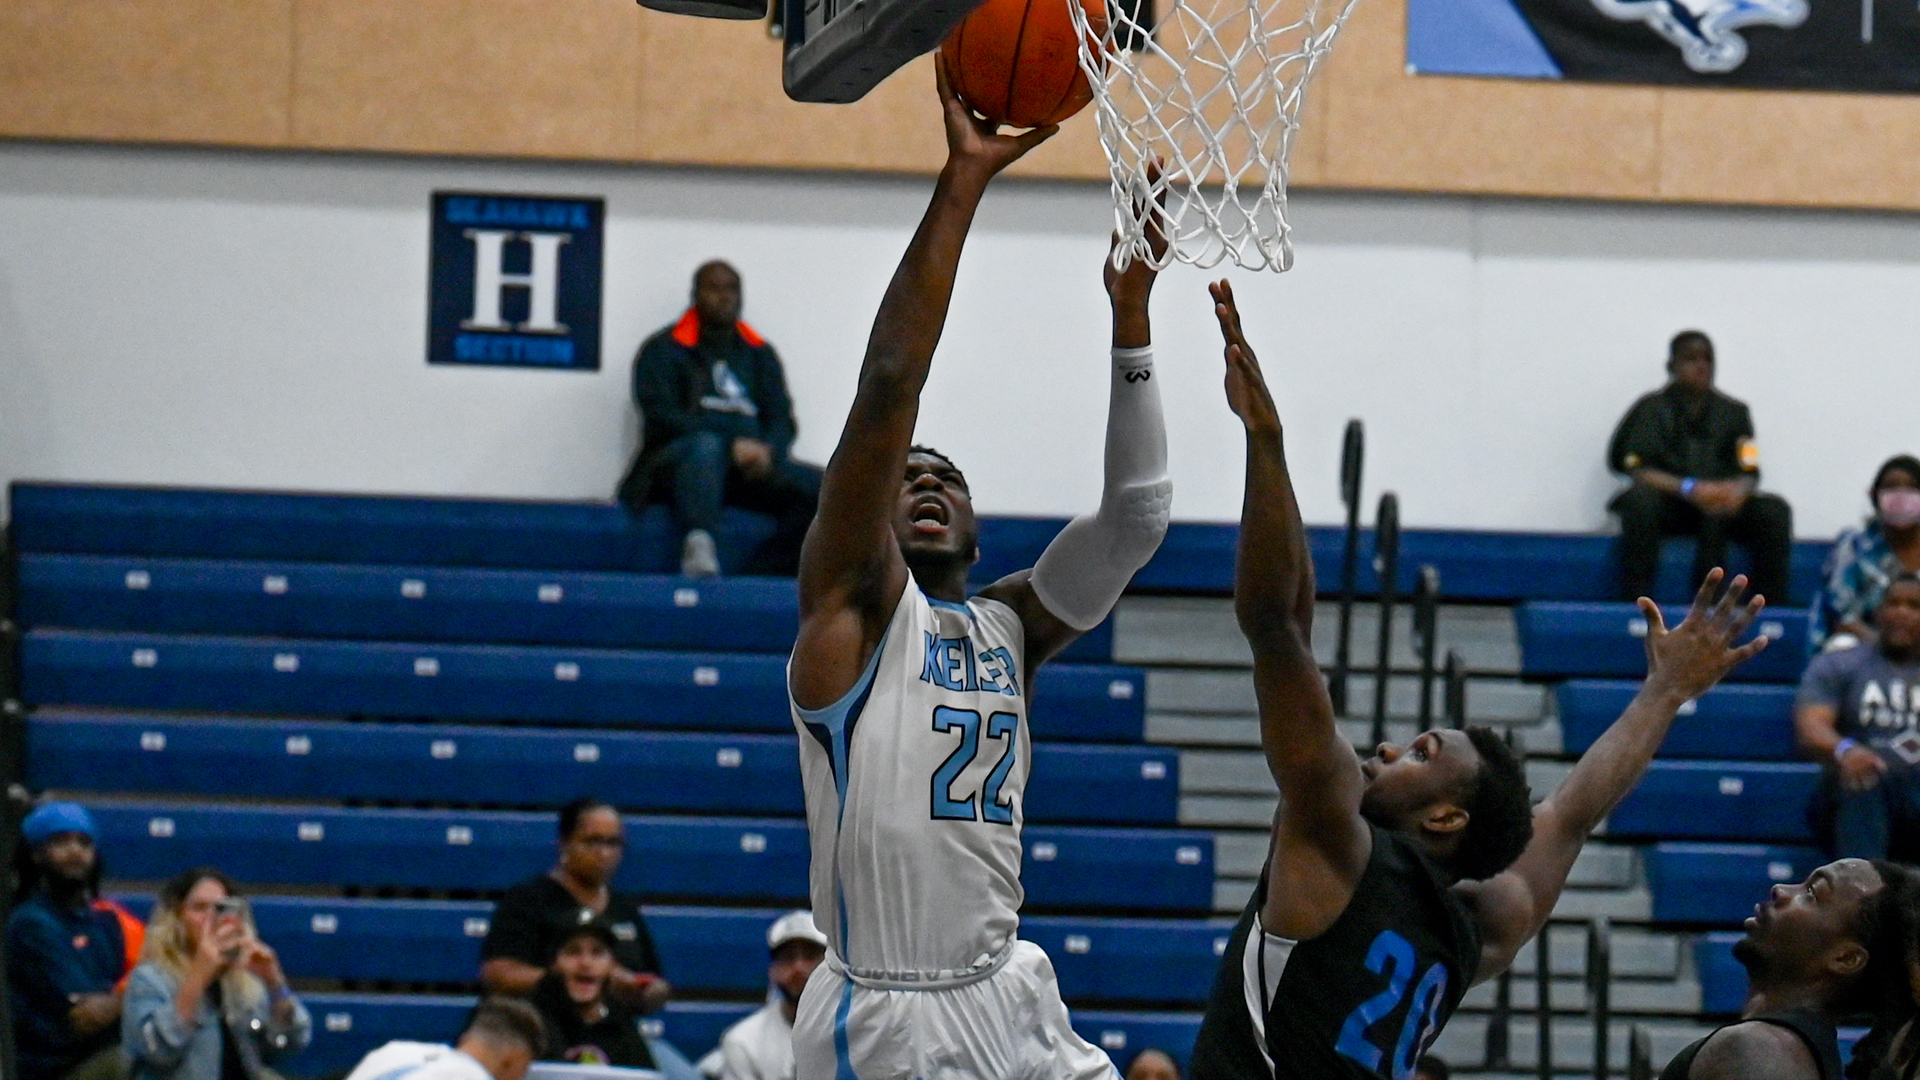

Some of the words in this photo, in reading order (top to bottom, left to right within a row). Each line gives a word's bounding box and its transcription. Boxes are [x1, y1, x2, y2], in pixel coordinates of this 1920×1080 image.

[460, 229, 572, 334] H
[930, 705, 1018, 826] 22
[1334, 929, 1448, 1080] 20
